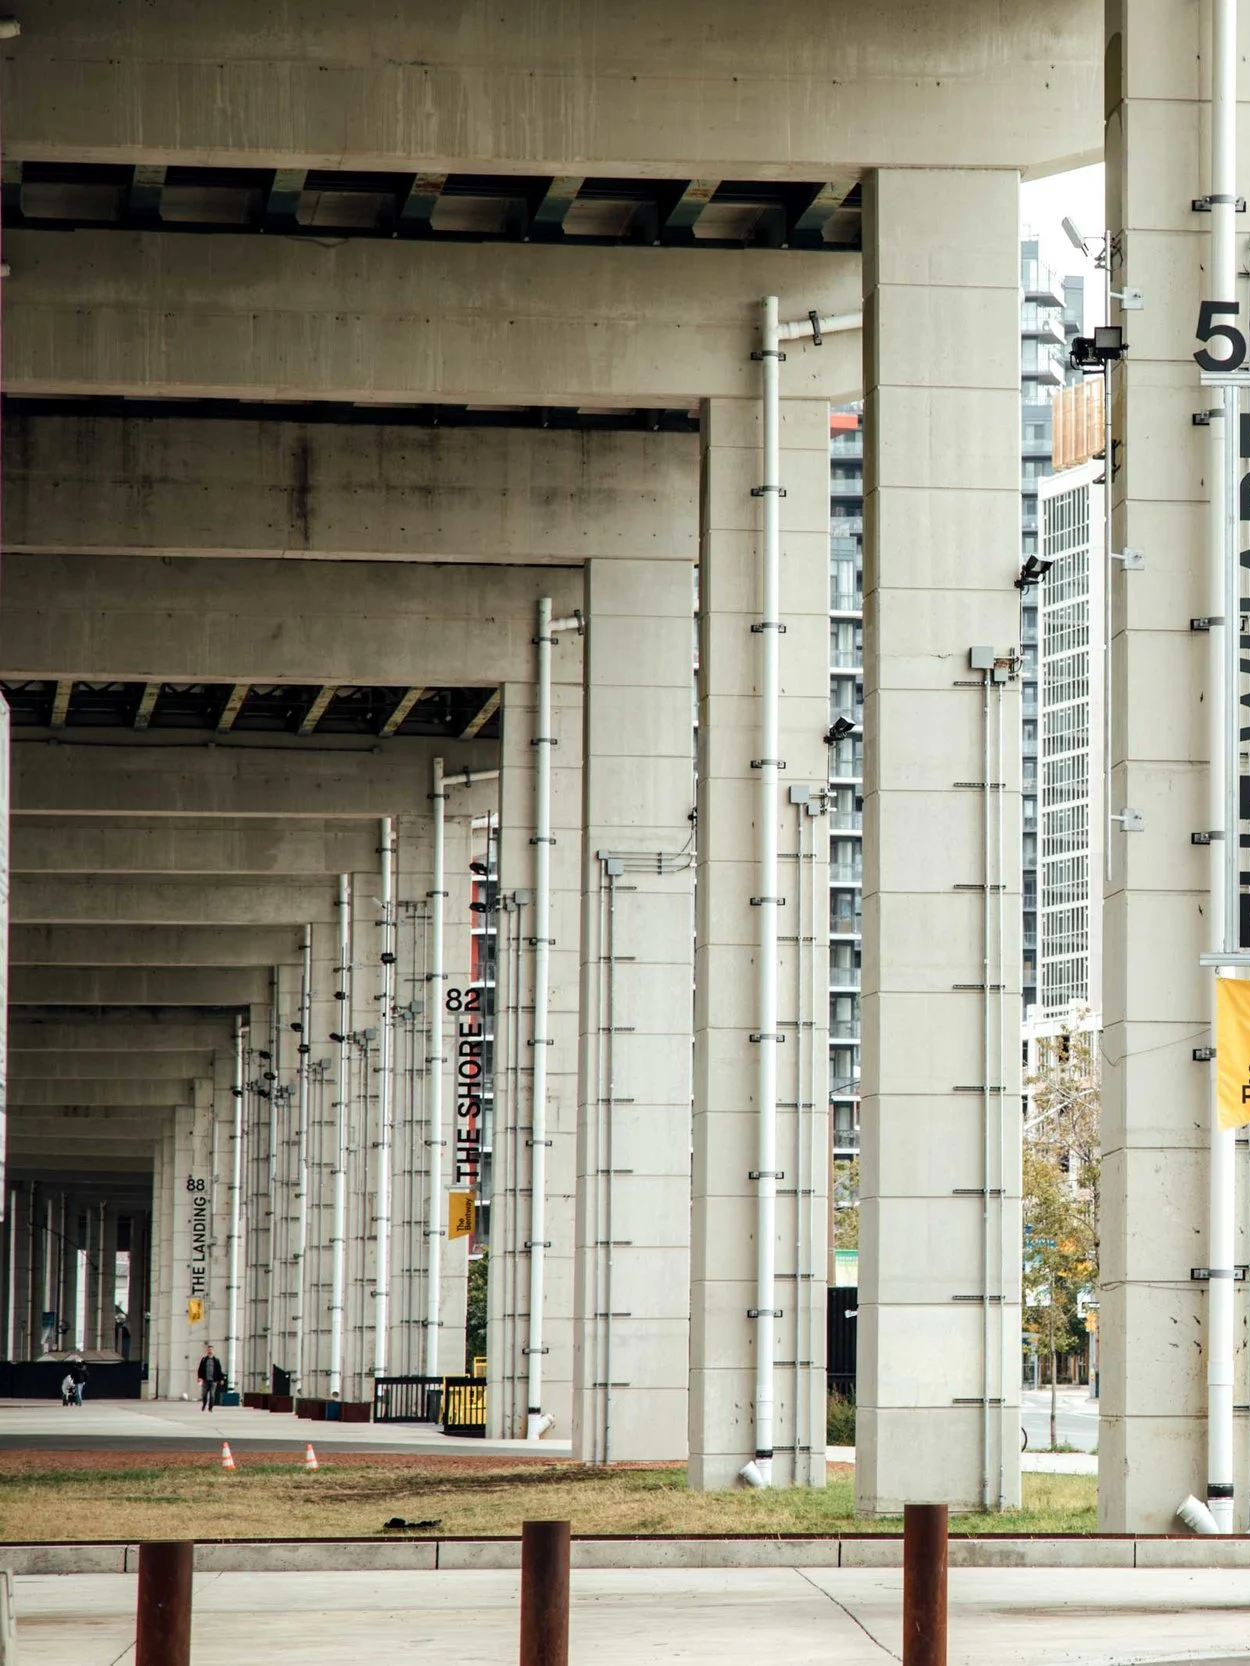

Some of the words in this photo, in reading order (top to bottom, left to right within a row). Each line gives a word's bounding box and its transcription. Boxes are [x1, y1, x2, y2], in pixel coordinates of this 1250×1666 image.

[446, 988, 482, 1012] 82
[458, 1022, 483, 1118] SHORE
[456, 1129, 480, 1182] THE
[186, 1178, 205, 1192] 88
[193, 1196, 206, 1261] LANDING
[456, 1217, 466, 1233] The
[464, 1198, 473, 1231] Bentway
[192, 1266, 205, 1295] THE
